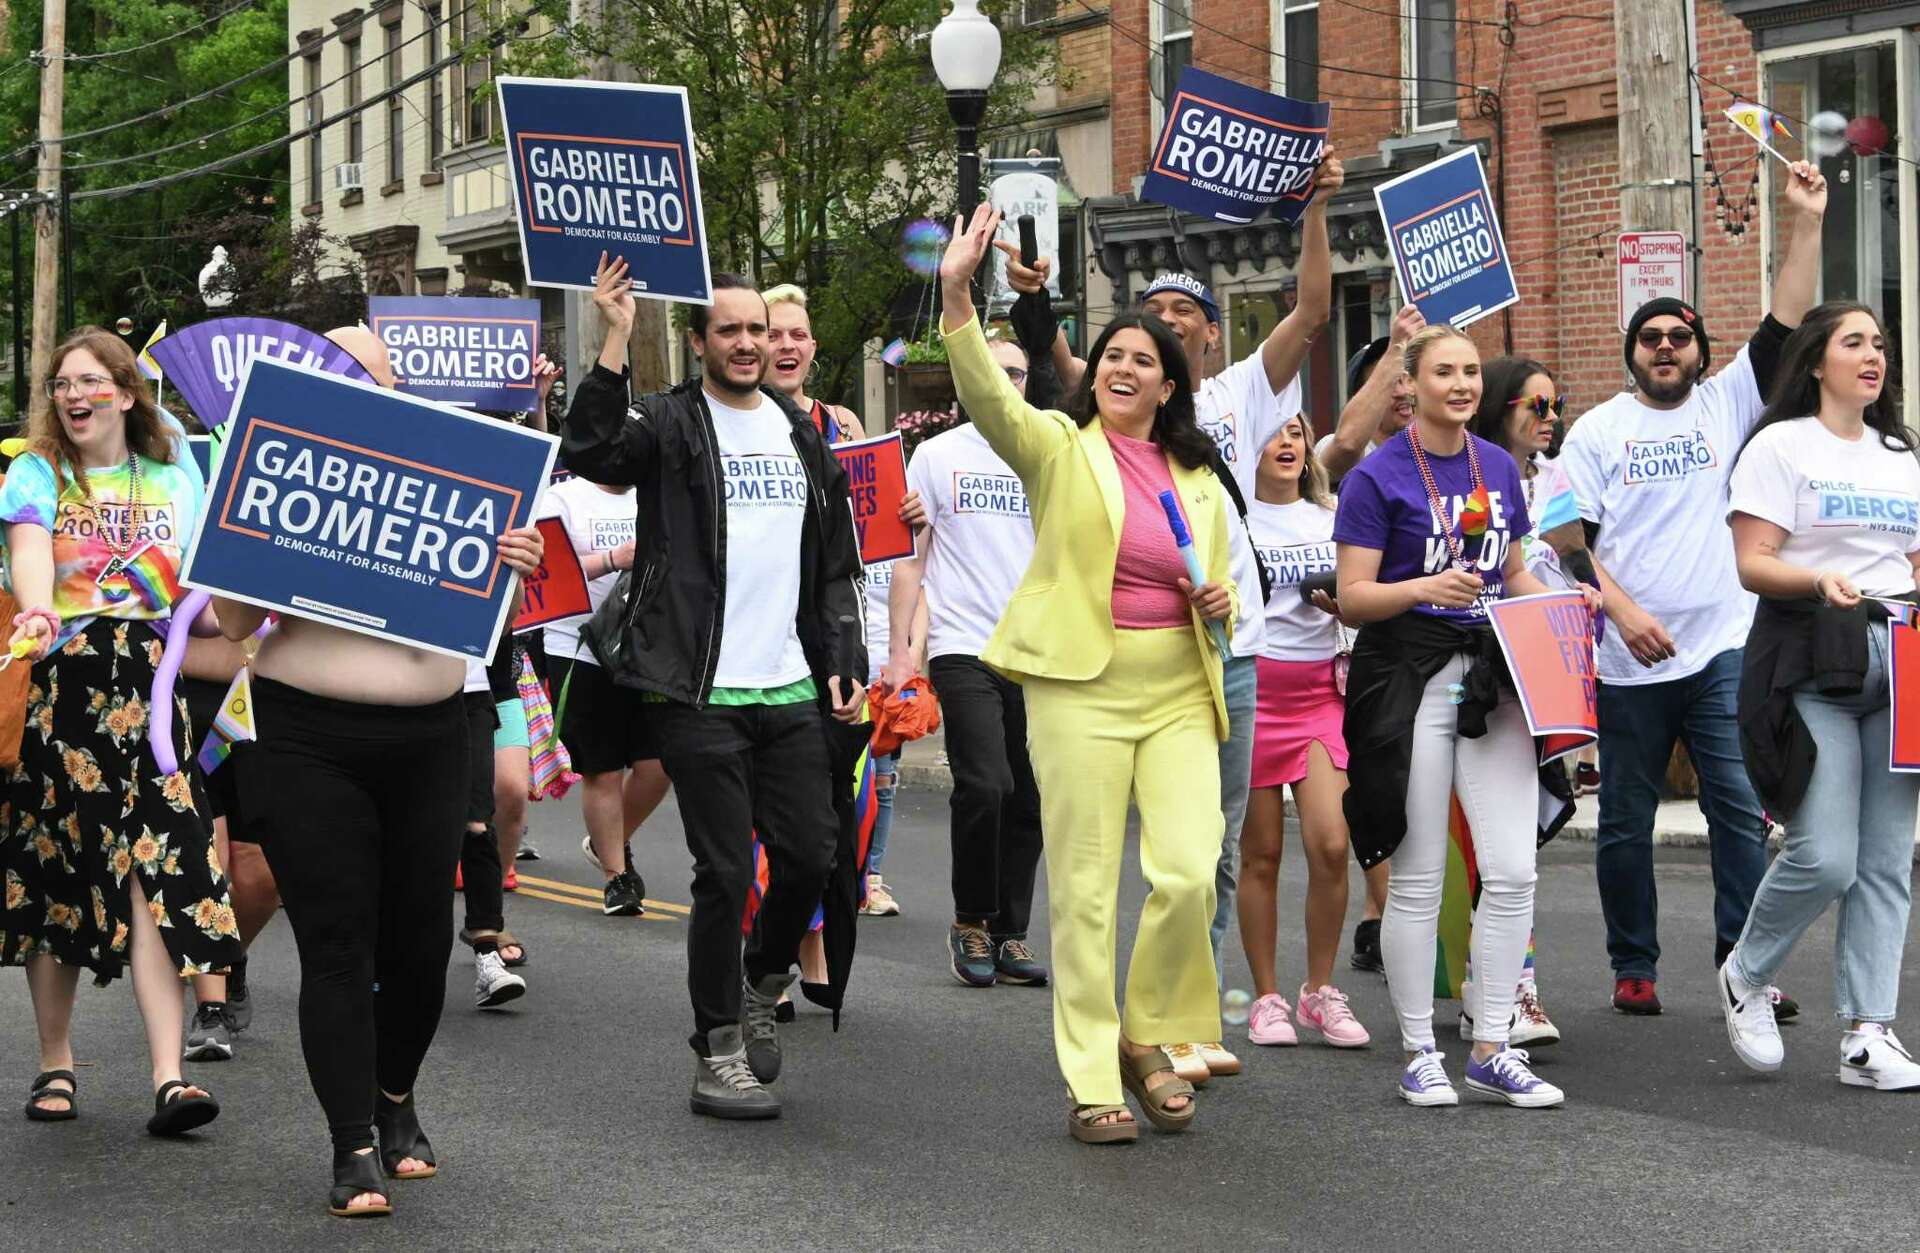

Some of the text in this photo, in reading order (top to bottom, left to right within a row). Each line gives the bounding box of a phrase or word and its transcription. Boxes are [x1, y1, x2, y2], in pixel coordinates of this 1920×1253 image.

[1181, 108, 1324, 164] GABRIELLA
[530, 147, 678, 188] GABRIELLA
[1167, 135, 1314, 194] ROMERO
[1191, 178, 1239, 199] DEMOCRAT
[1239, 191, 1255, 202] FOR
[534, 182, 684, 232] ROMERO
[565, 226, 661, 244] DEMOCRAT FOR ASSEMBLY
[1401, 202, 1485, 257] GABRIELLA
[1408, 228, 1492, 290] ROMERO
[1621, 241, 1681, 259] NO STOPPING
[1429, 265, 1483, 295] DEMOCRAT FOR ASSEMBLY
[1639, 265, 1664, 275] EXCEPT
[1639, 278, 1648, 287] PM
[1651, 277, 1674, 287] THURS
[1648, 290, 1656, 298] TO
[383, 325, 529, 350] GABRIELLA
[388, 348, 530, 380] ROMERO
[408, 378, 504, 389] DEMOCRAT FOR ASSEMBLY
[722, 460, 804, 478] BRIELLA
[255, 440, 495, 535] GABRIELLA
[725, 479, 806, 500] OMERO
[960, 476, 1026, 494] GABRIE
[1809, 480, 1856, 491] CHLOE
[960, 492, 1029, 512] ROME
[1825, 495, 1918, 523] PIERCE
[238, 476, 490, 579] ROMERO
[595, 522, 634, 533] GABRI
[1869, 522, 1888, 532] NYS
[595, 534, 632, 547] ROM
[274, 534, 437, 586] DEMOCRAT FOR ASSEMBLY
[1257, 546, 1334, 562] ABRIELL
